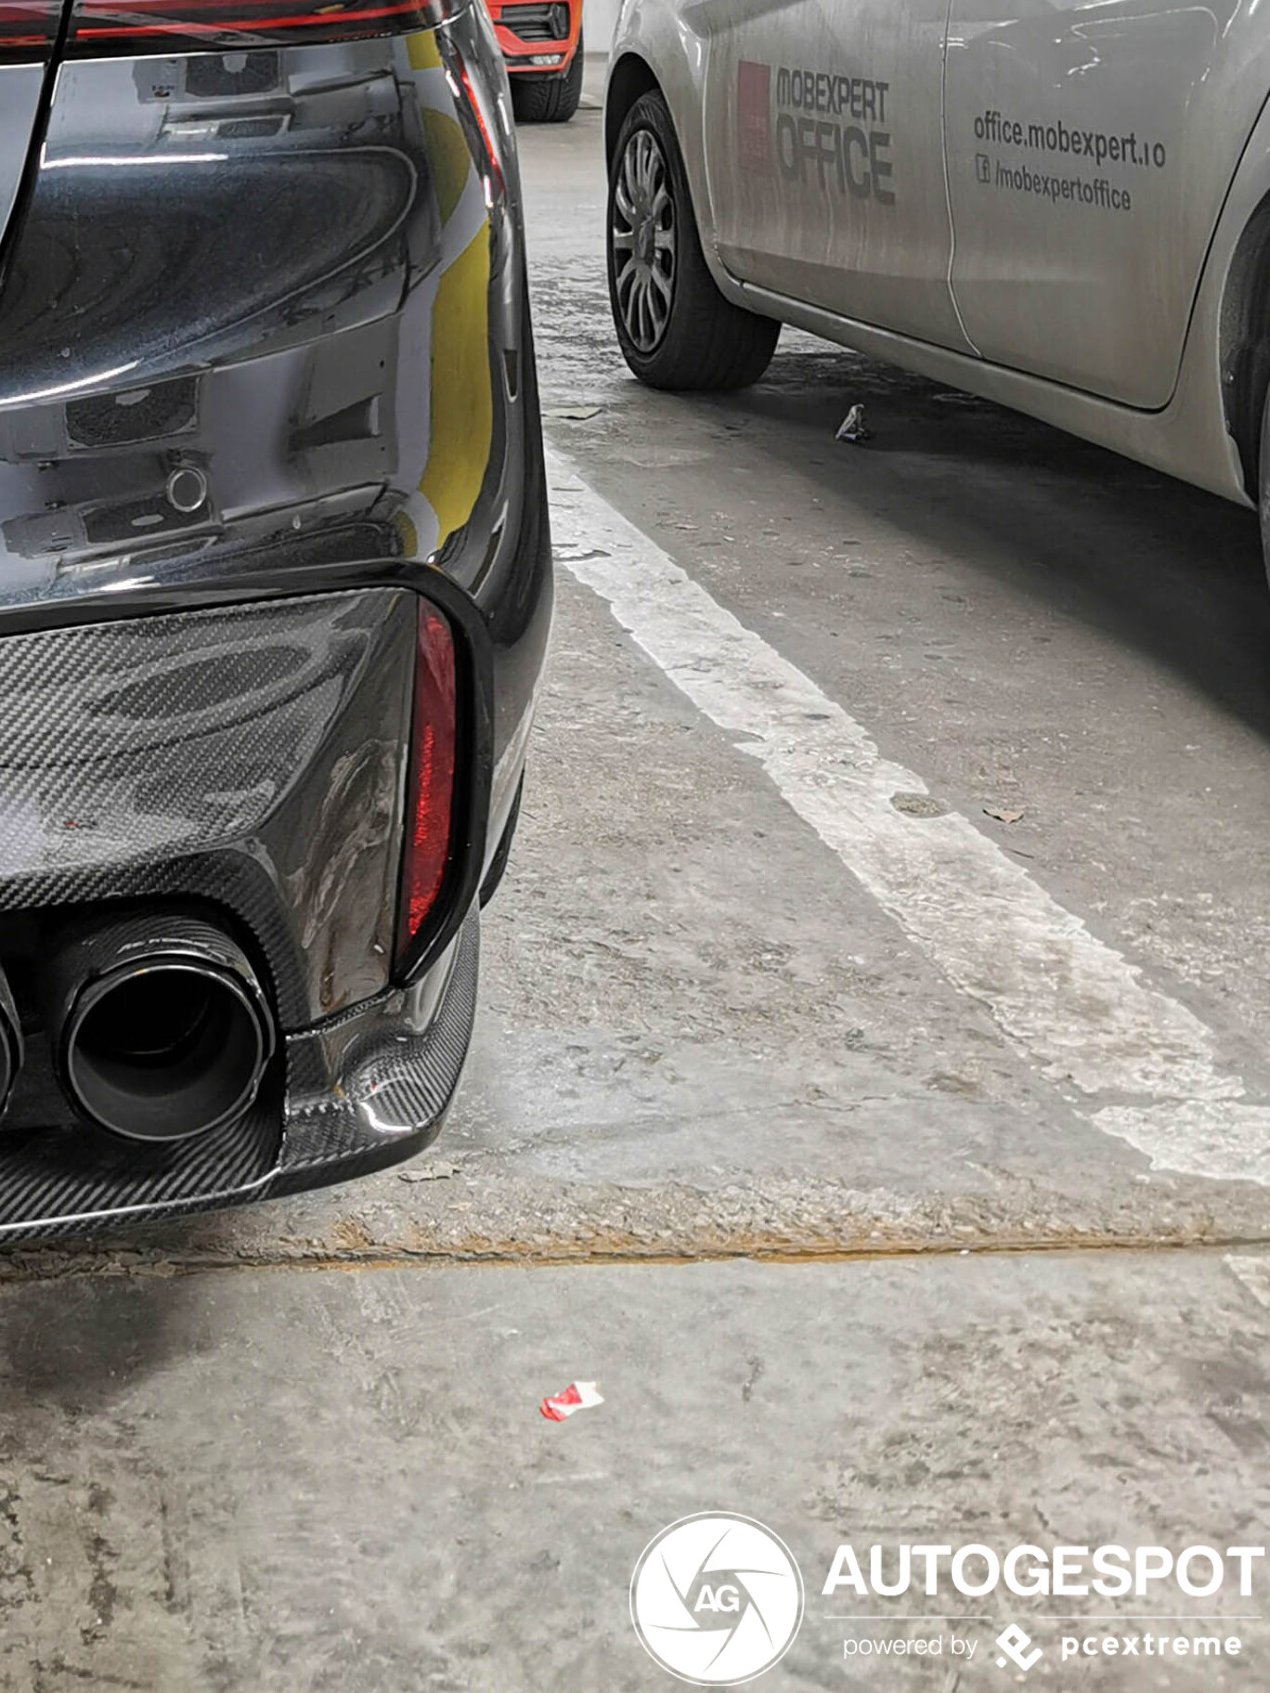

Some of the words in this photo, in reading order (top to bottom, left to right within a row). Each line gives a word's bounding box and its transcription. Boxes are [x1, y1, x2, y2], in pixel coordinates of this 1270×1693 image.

[776, 67, 890, 123] MOBEXPERT
[776, 113, 896, 206] OFFICE
[996, 159, 1131, 211] /mobexpertoffice
